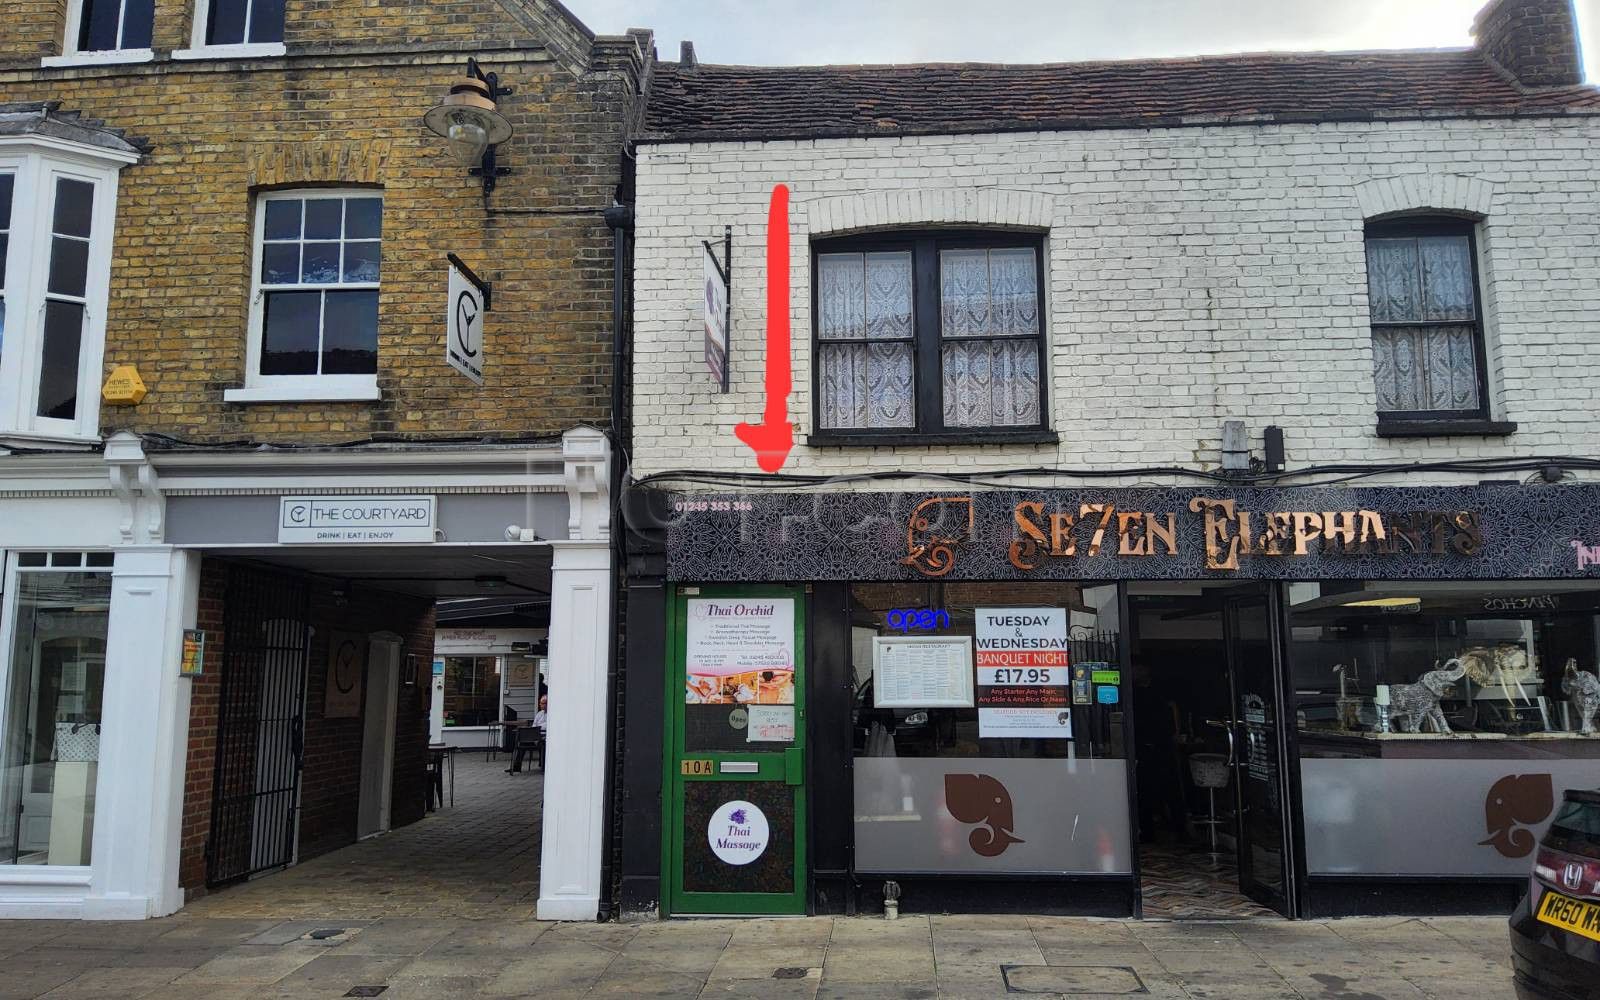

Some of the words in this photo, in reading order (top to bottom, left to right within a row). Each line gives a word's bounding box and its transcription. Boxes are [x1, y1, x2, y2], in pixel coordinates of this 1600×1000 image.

[313, 508, 339, 520] THE
[342, 508, 427, 520] COURTYARD
[707, 604, 732, 616] Thai
[734, 604, 774, 616] Orchid
[887, 608, 949, 633] open
[986, 616, 1050, 627] TUESDAY
[1014, 627, 1023, 638] &
[976, 638, 1068, 649] WEDNESDAY
[976, 653, 1030, 665] BANQUET
[1033, 653, 1068, 664] NIGHT
[994, 669, 1051, 683] £17.95
[684, 761, 712, 773] 10A
[727, 825, 751, 836] Thai
[716, 838, 761, 851] Massage
